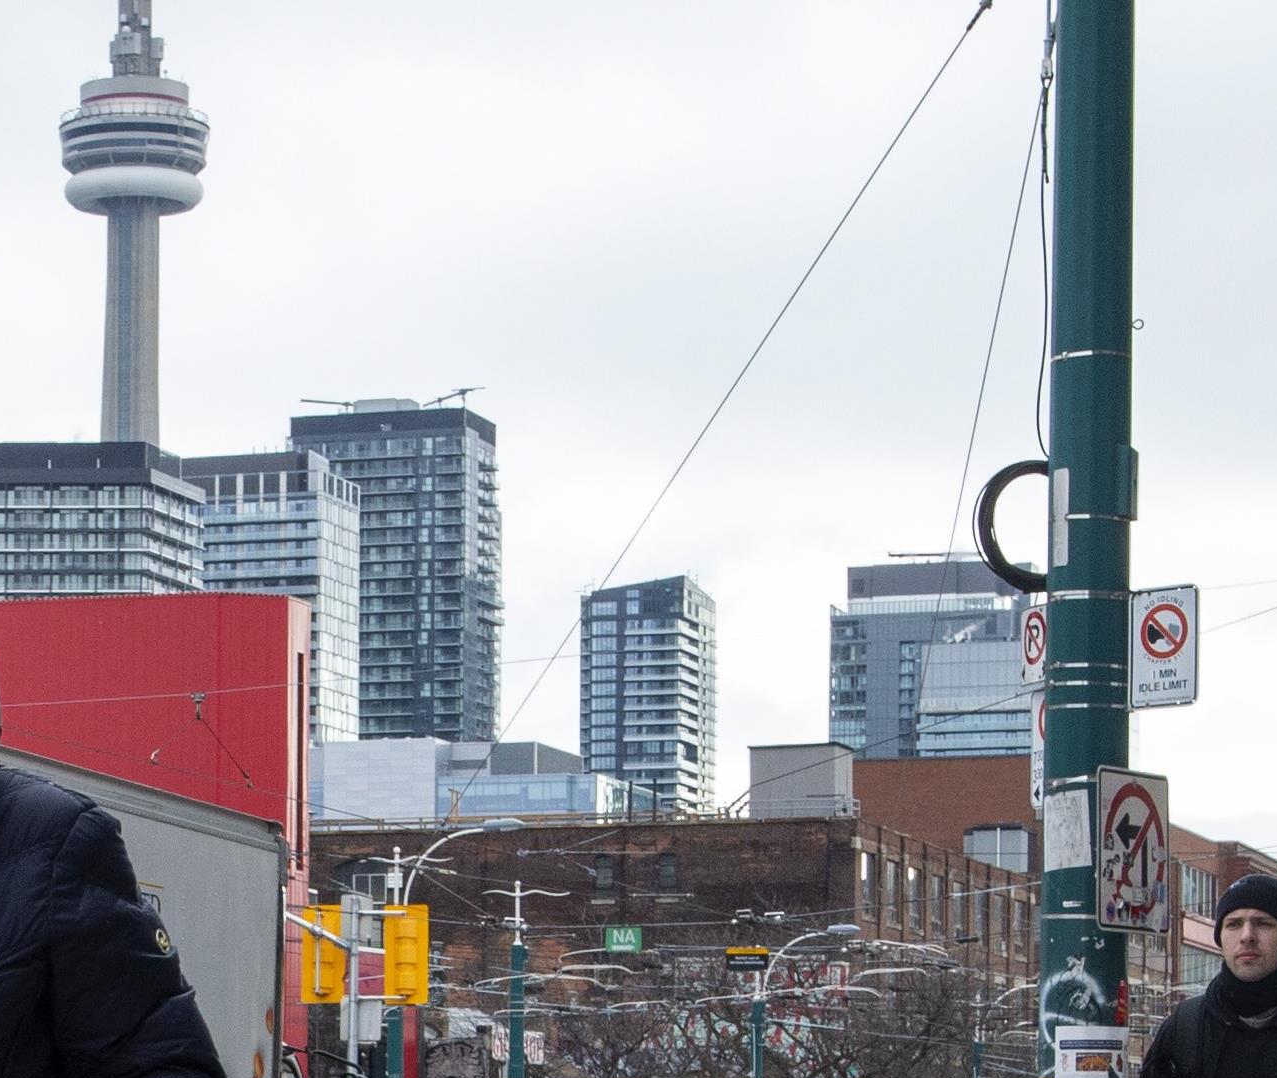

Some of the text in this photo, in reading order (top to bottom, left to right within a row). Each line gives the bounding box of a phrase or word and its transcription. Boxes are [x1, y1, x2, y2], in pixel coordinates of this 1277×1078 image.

[1144, 595, 1185, 611] NO IDLING
[1159, 668, 1177, 679] MIN
[1138, 680, 1188, 693] IDLE LIMIT
[612, 929, 636, 944] NA
